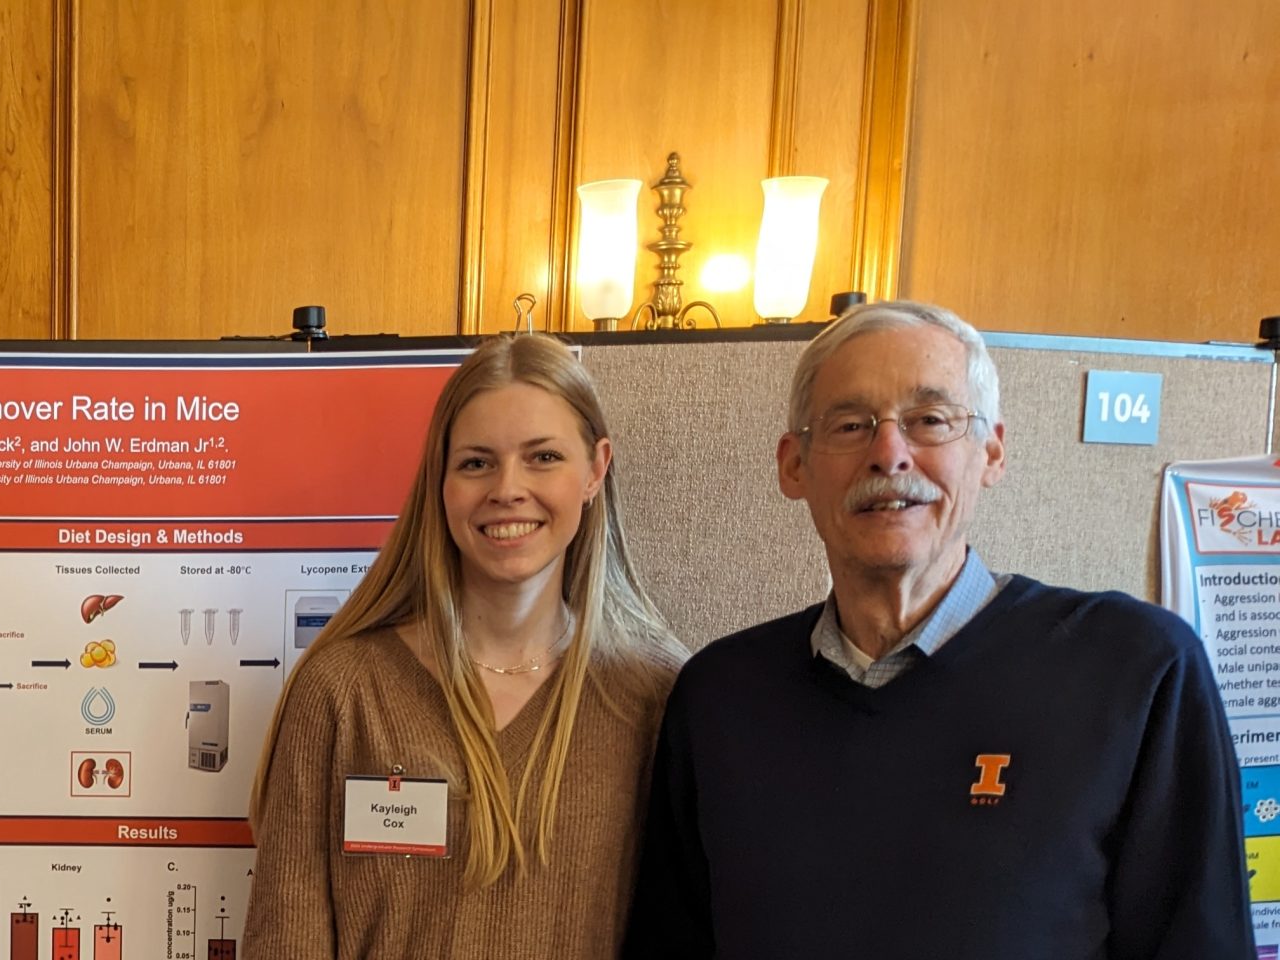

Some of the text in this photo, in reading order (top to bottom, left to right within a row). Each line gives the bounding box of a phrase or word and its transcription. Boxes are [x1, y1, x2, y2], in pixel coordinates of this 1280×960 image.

[73, 396, 134, 421] Rate
[145, 396, 166, 420] in
[177, 396, 239, 421] Mice
[1098, 392, 1151, 424] 104
[30, 437, 58, 452] and
[63, 438, 100, 452] John
[105, 438, 124, 452] W.
[130, 438, 189, 453] Erdman
[23, 459, 33, 468] of
[34, 459, 63, 469] Illinois
[65, 459, 98, 469] Urbana
[101, 460, 154, 471] Champaign,
[158, 460, 193, 470] Urbana,
[208, 460, 236, 469] 61801
[14, 474, 24, 483] of
[25, 475, 53, 484] Illinois
[56, 474, 89, 484] Urbana
[92, 475, 145, 486] Champaign,
[149, 475, 184, 485] Urbana,
[198, 475, 226, 484] 61801
[59, 529, 243, 546] Diet Design & Methods
[56, 565, 140, 575] Tissues Collected
[180, 566, 212, 574] Stored
[215, 566, 224, 574] at
[301, 564, 348, 576] Lycopene
[1200, 572, 1280, 587] Introductio
[1214, 592, 1276, 607] Aggression
[1215, 610, 1248, 622] and is
[1216, 627, 1277, 641] Aggression
[1217, 644, 1247, 657] social
[1218, 660, 1244, 674] Male
[371, 803, 417, 816] Kayleigh
[383, 818, 404, 829] Cox
[118, 825, 177, 839] Results
[52, 864, 82, 873] Kidney
